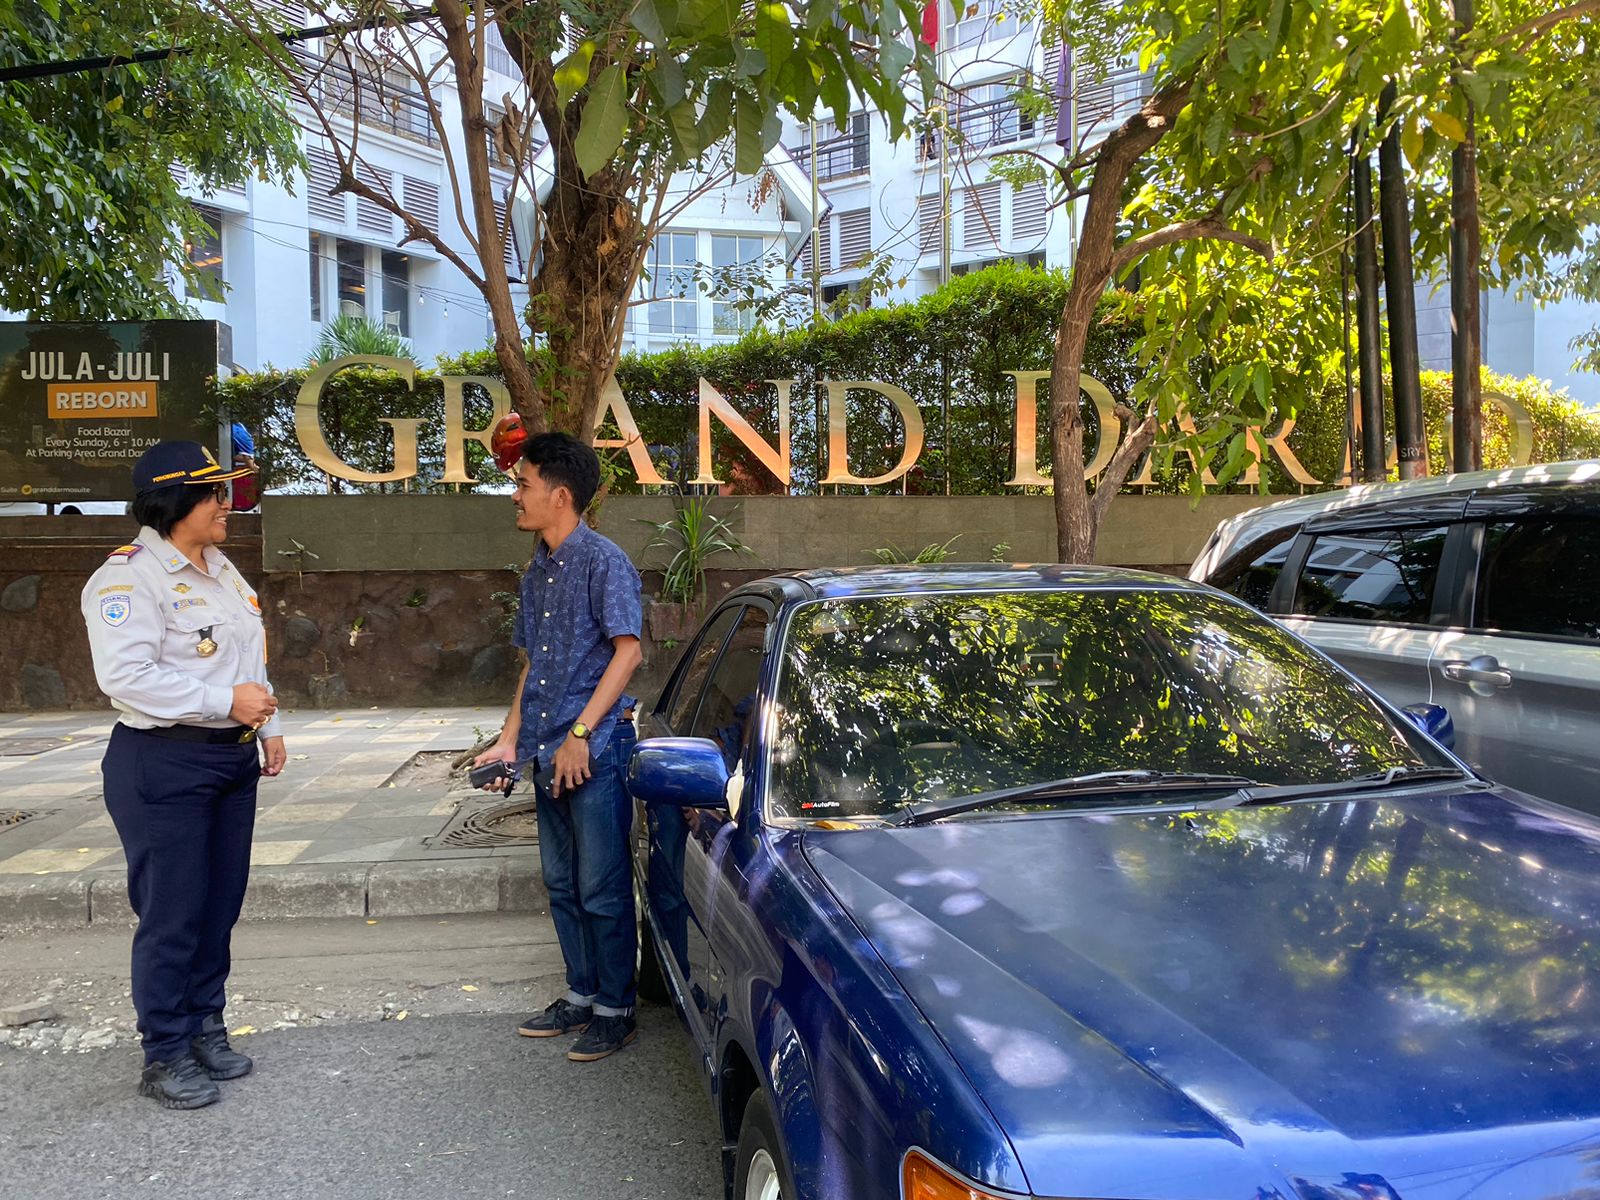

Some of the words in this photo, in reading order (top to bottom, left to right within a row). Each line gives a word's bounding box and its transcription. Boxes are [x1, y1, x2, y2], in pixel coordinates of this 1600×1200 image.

[21, 351, 170, 381] JULA-JULI
[55, 391, 148, 409] REBORN
[295, 354, 926, 486] GRAND
[77, 427, 102, 436] Food
[103, 427, 131, 437] Bazar
[45, 437, 71, 449] Every
[73, 437, 111, 449] Sunday,
[113, 438, 120, 447] 6
[131, 438, 144, 447] 10
[145, 438, 160, 447] AM
[26, 449, 37, 457] At
[38, 448, 72, 460] Parking
[74, 449, 96, 458] Area
[97, 448, 126, 458] Grand
